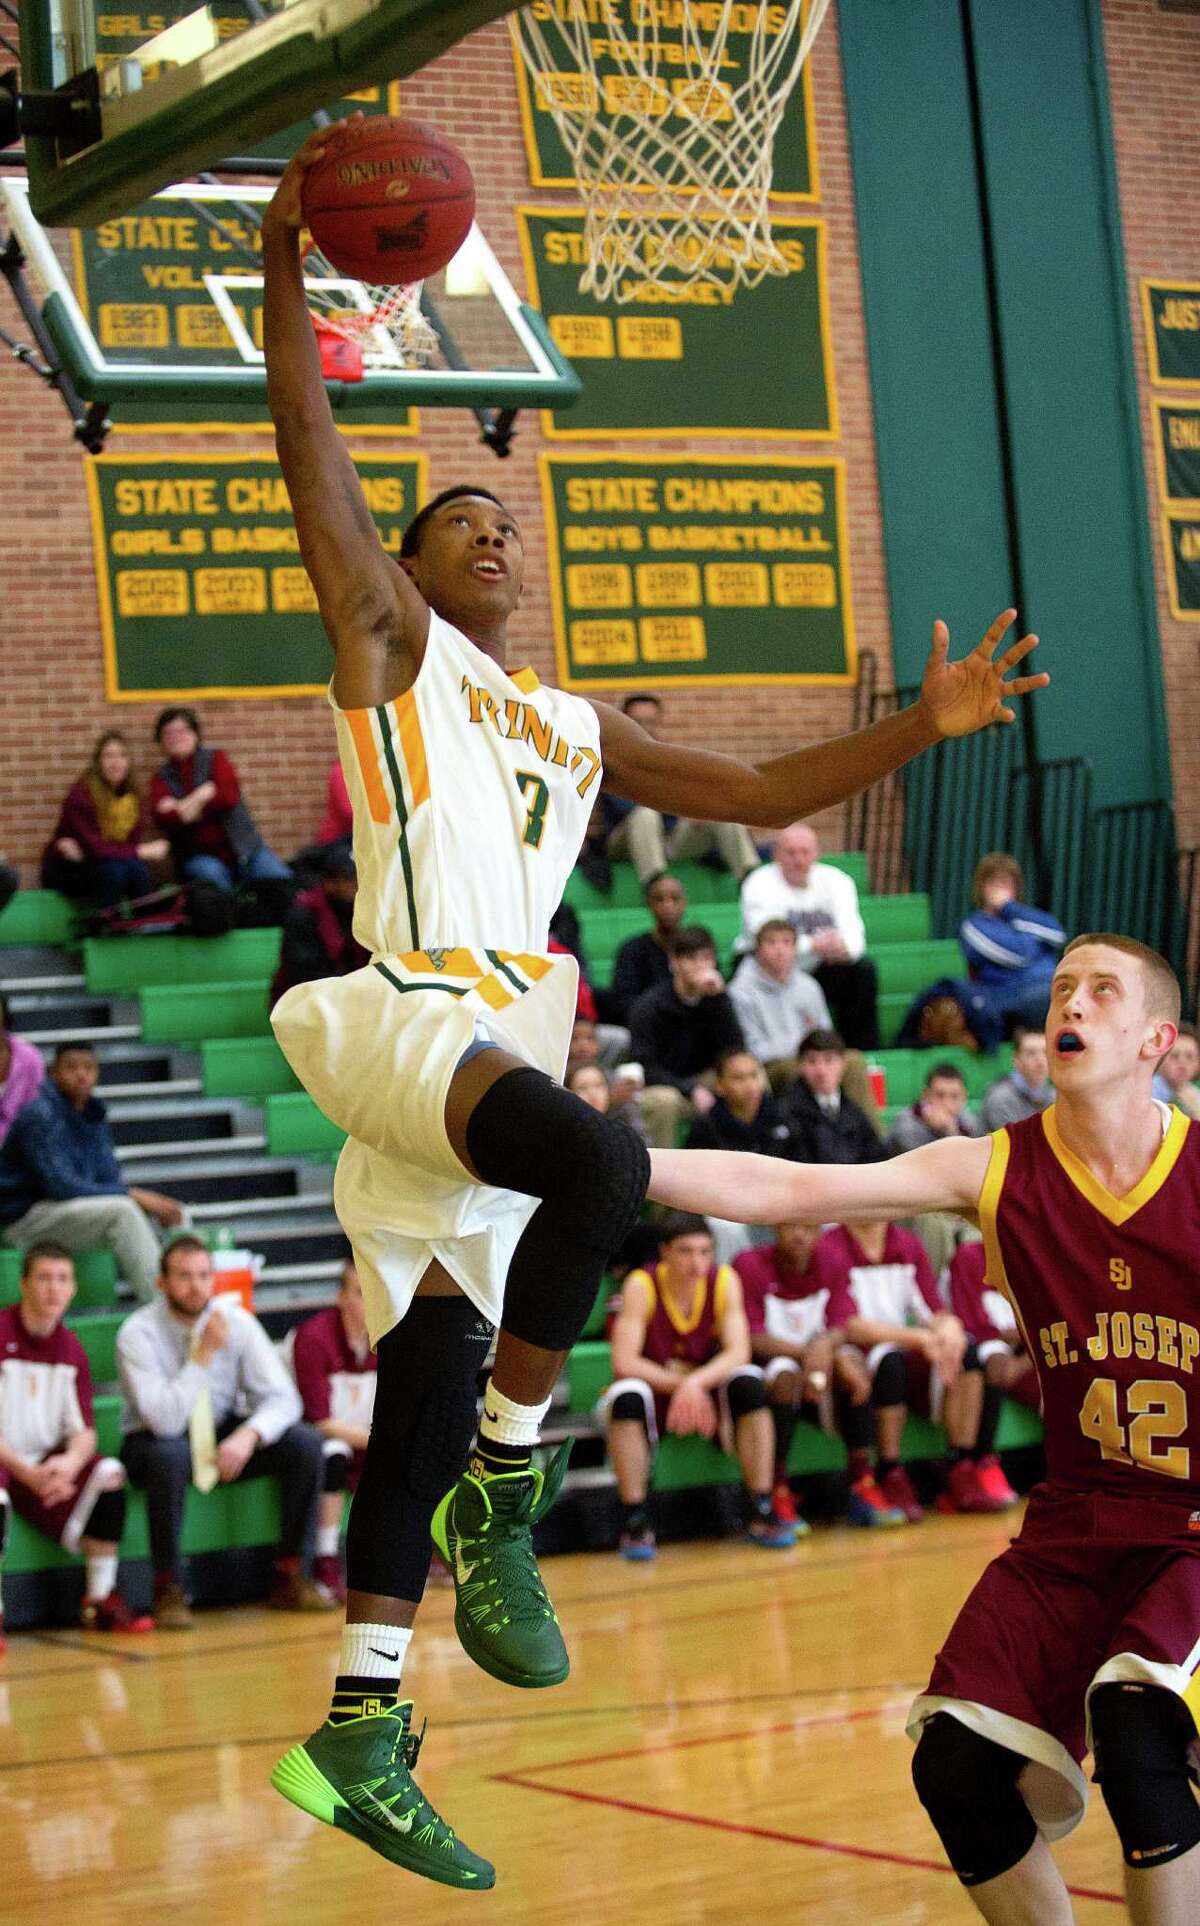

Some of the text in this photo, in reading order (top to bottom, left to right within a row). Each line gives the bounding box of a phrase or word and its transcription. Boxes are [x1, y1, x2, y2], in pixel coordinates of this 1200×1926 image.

[96, 216, 200, 250] STATE
[114, 478, 220, 516] STATE
[566, 478, 824, 516] STATE CHAMPIONS
[110, 529, 205, 556] GIRLS
[564, 526, 833, 552] BOYS BASKETBALL
[514, 768, 550, 851] 3
[1109, 1257, 1133, 1291] SJ
[1039, 1320, 1079, 1369] ST.
[1078, 1377, 1190, 1480] 42
